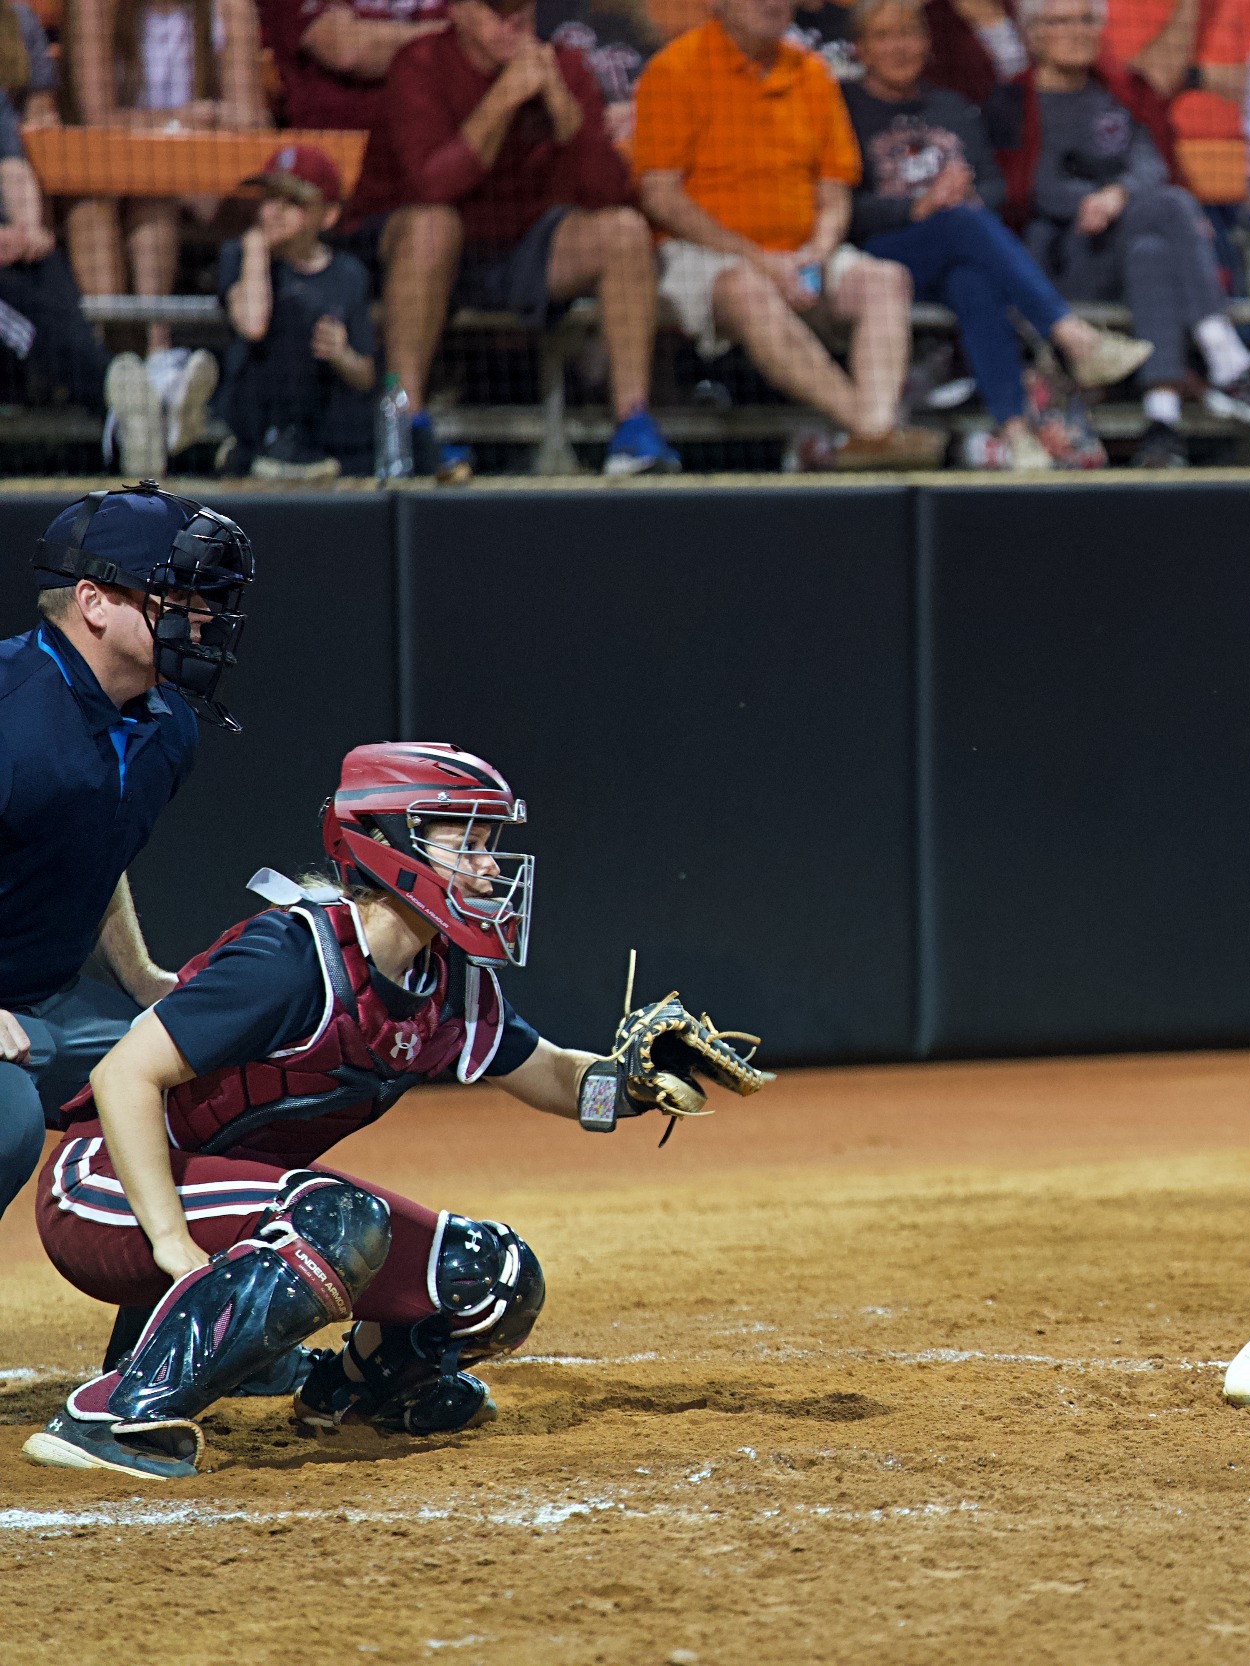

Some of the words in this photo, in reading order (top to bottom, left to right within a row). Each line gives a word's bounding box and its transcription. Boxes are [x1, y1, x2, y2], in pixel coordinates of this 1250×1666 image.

[405, 892, 426, 909] UNDER
[424, 908, 449, 929] ARMOUR
[294, 1249, 328, 1282] UNDER
[324, 1282, 347, 1314] ARMOUR
